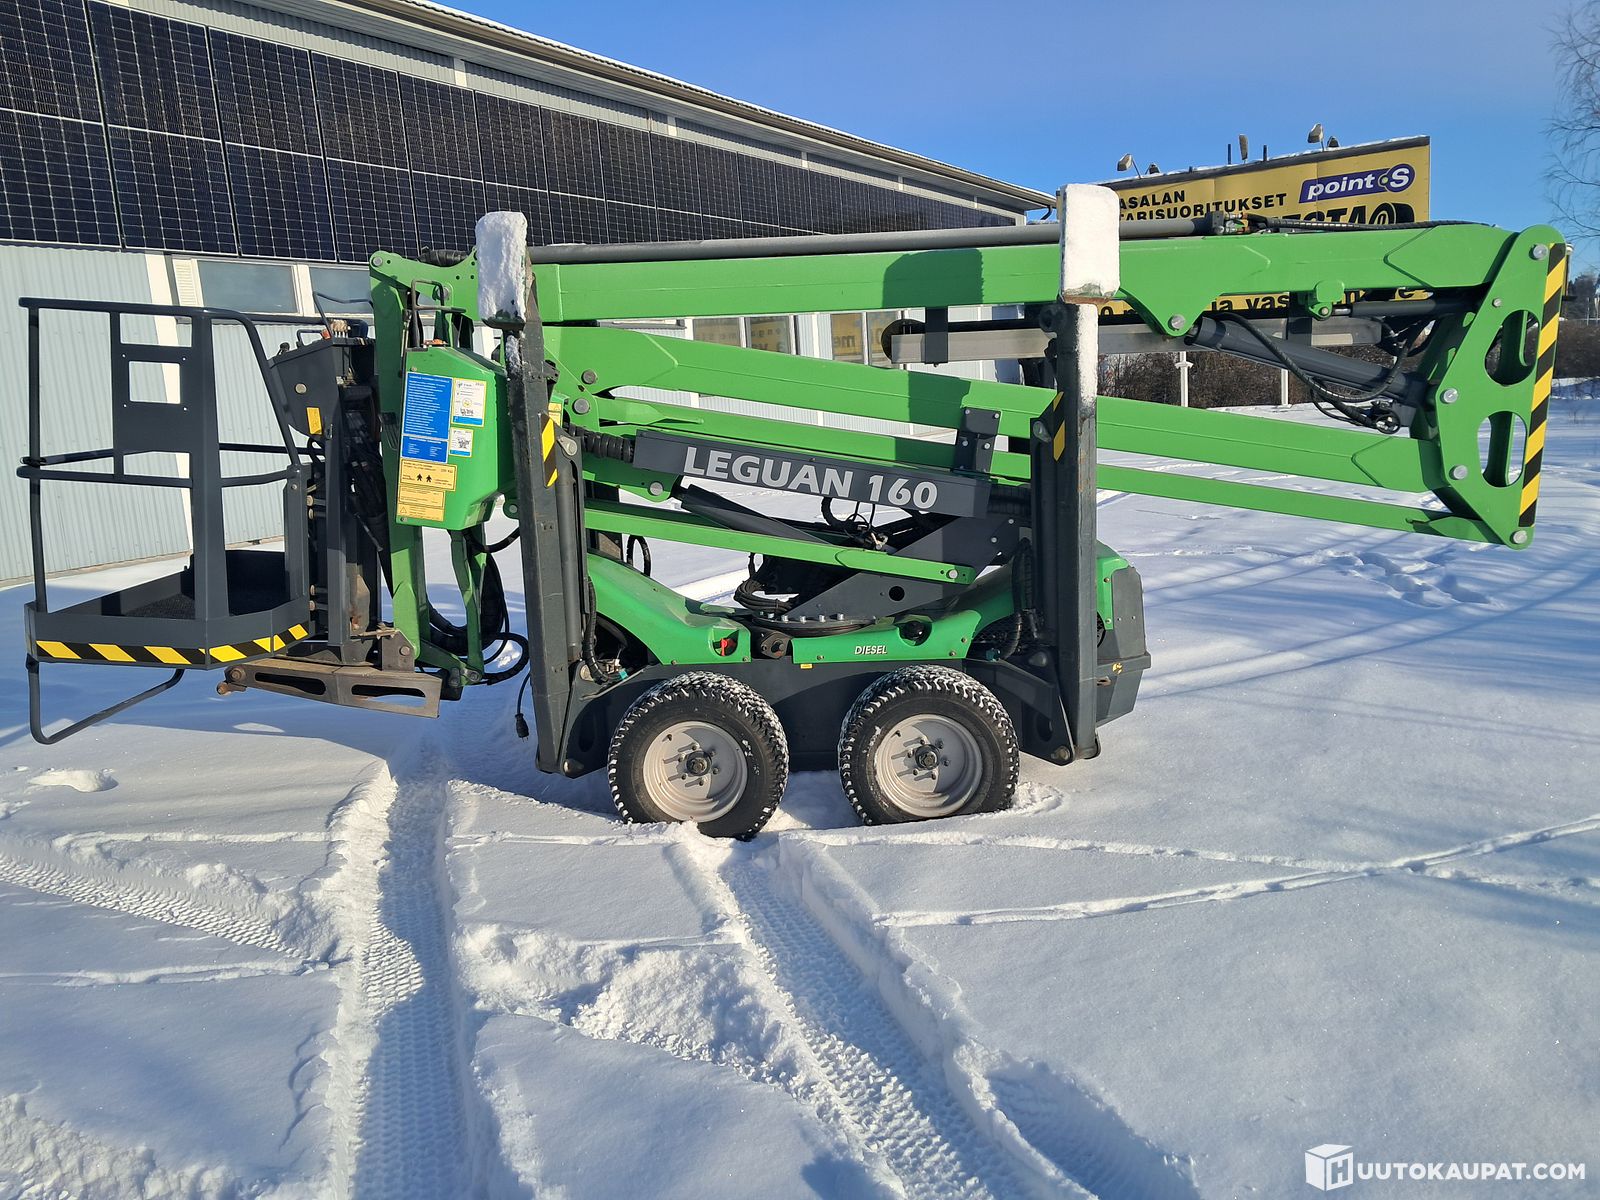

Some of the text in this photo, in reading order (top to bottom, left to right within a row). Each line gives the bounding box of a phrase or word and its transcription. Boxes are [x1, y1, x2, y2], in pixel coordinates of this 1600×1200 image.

[1307, 173, 1376, 201] point
[1119, 190, 1185, 210] ASALAN
[683, 446, 938, 509] LEGUAN 160
[855, 645, 888, 655] DIESEL
